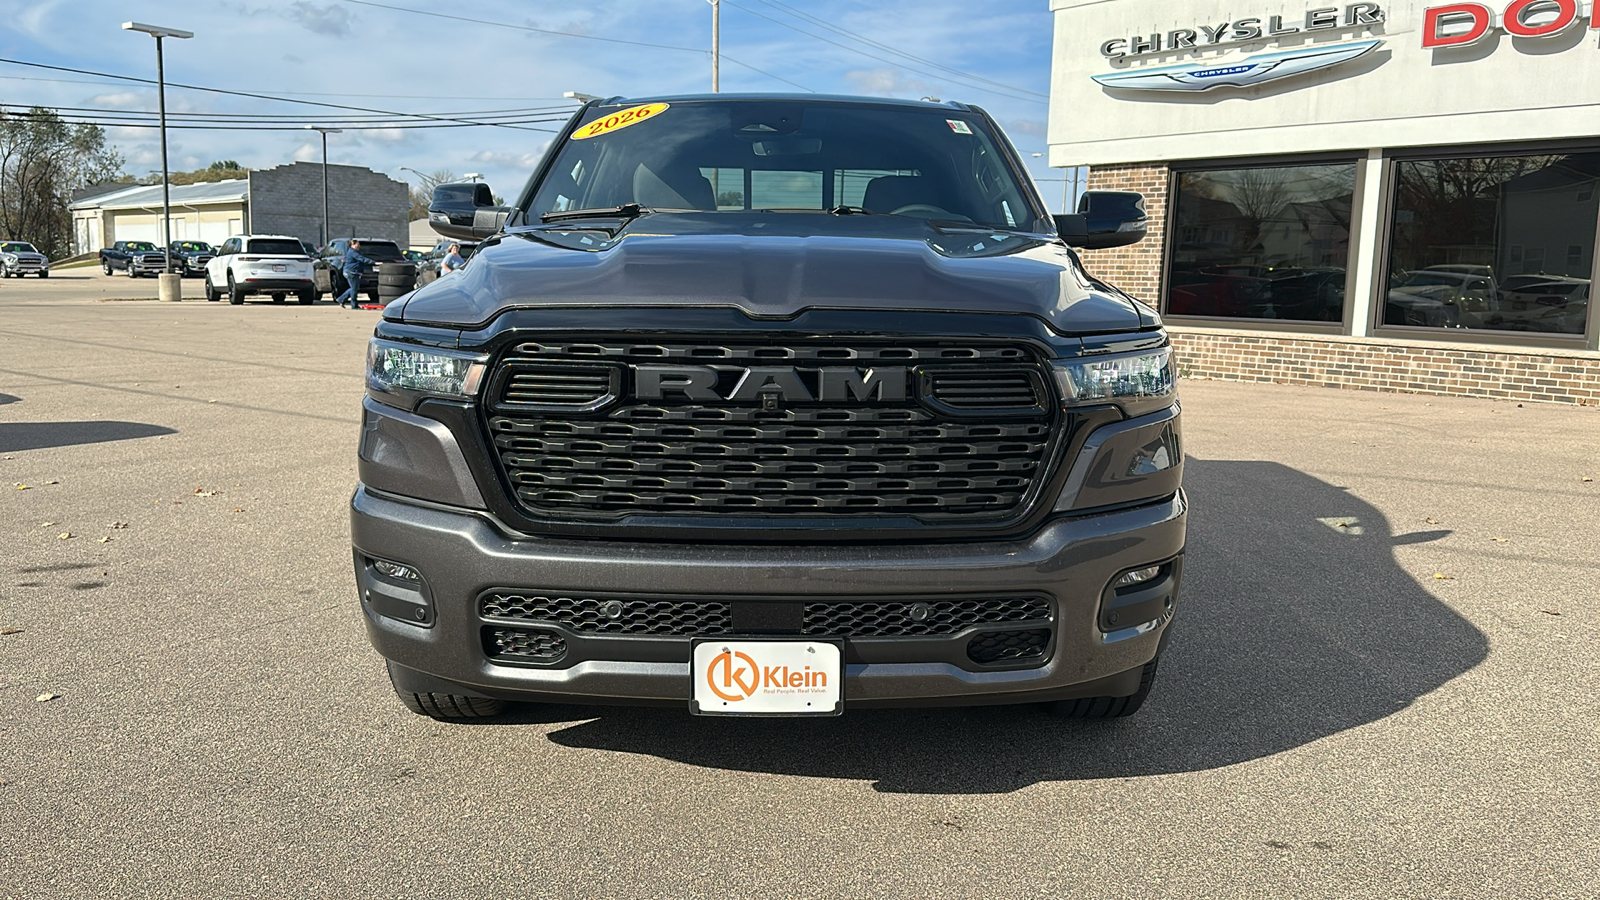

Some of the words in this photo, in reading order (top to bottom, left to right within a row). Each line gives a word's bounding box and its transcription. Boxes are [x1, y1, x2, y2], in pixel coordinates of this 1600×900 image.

[1100, 2, 1383, 58] CHRYSLER
[1421, 0, 1600, 49] DO
[1193, 66, 1249, 76] CHRYSLER
[589, 106, 650, 135] 2026
[634, 365, 907, 401] RAM
[763, 666, 827, 688] Klein
